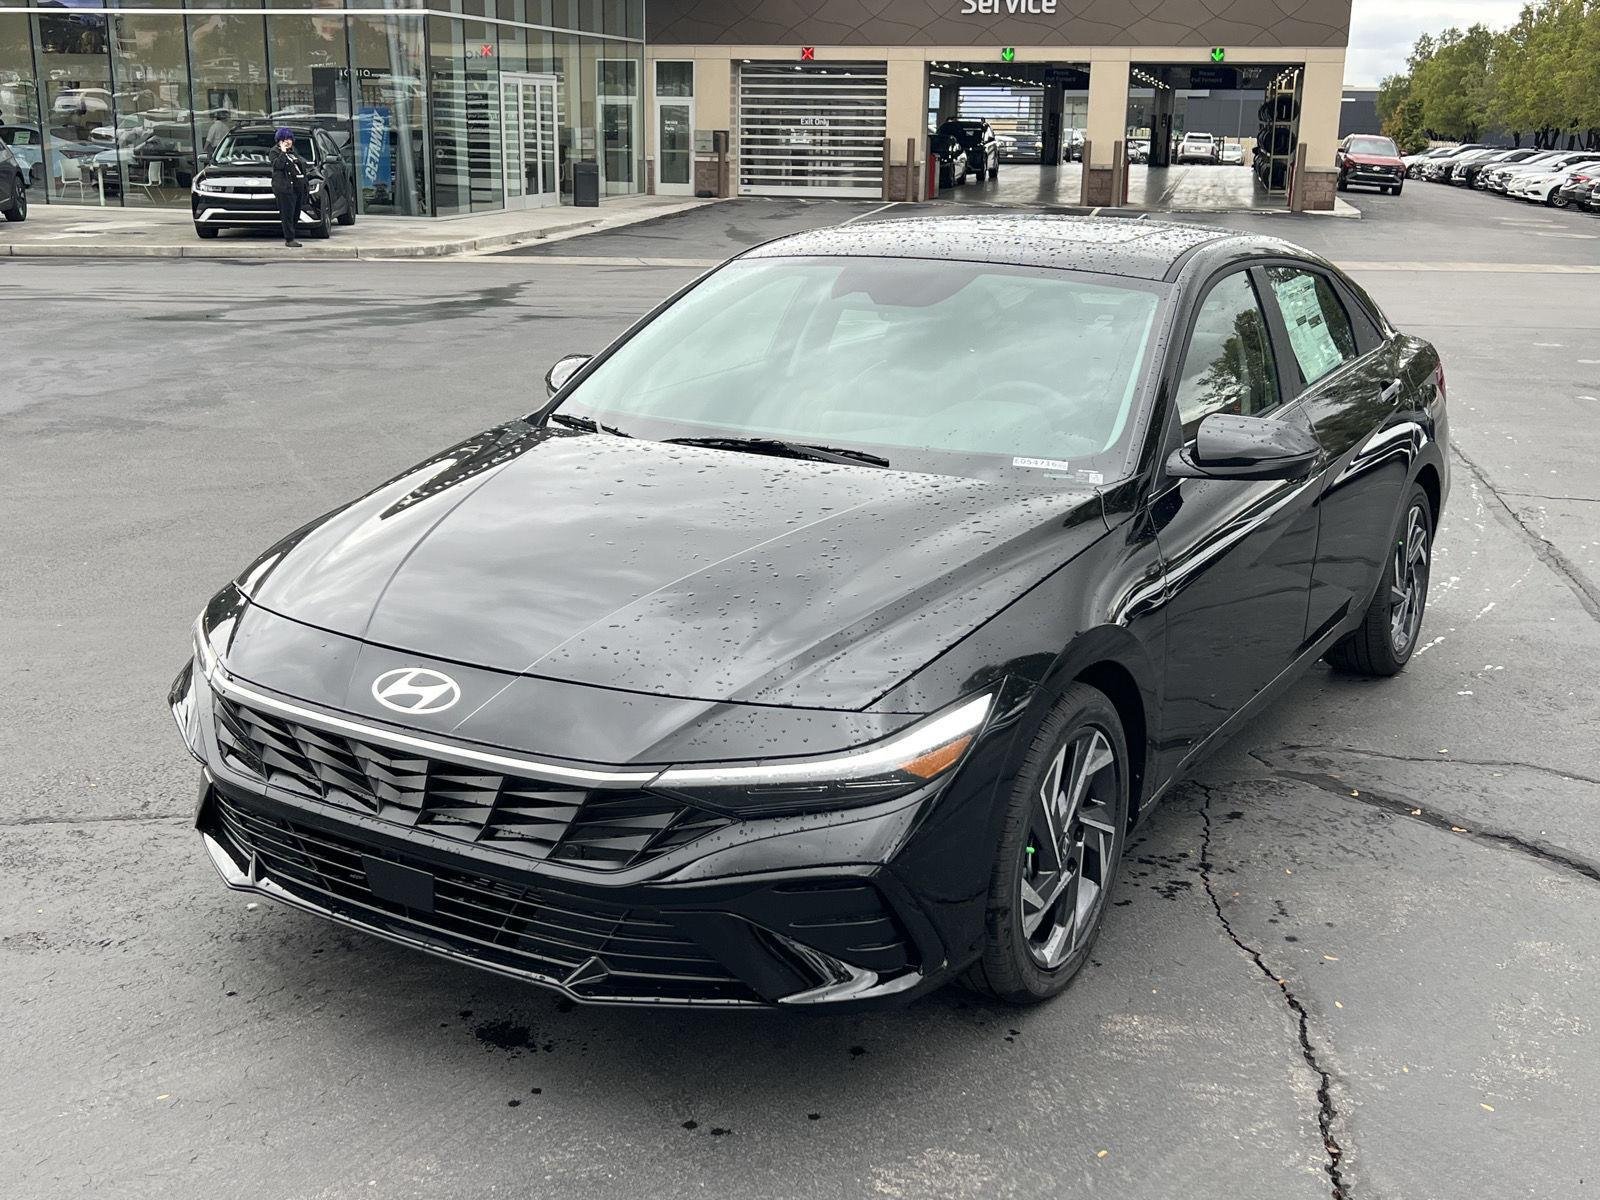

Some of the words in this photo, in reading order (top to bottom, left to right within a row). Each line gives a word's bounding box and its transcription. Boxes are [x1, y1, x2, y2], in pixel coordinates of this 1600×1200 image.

[961, 0, 1057, 14] Service
[801, 117, 813, 125] Exit
[814, 117, 830, 127] Only
[365, 109, 385, 181] GETAWAY
